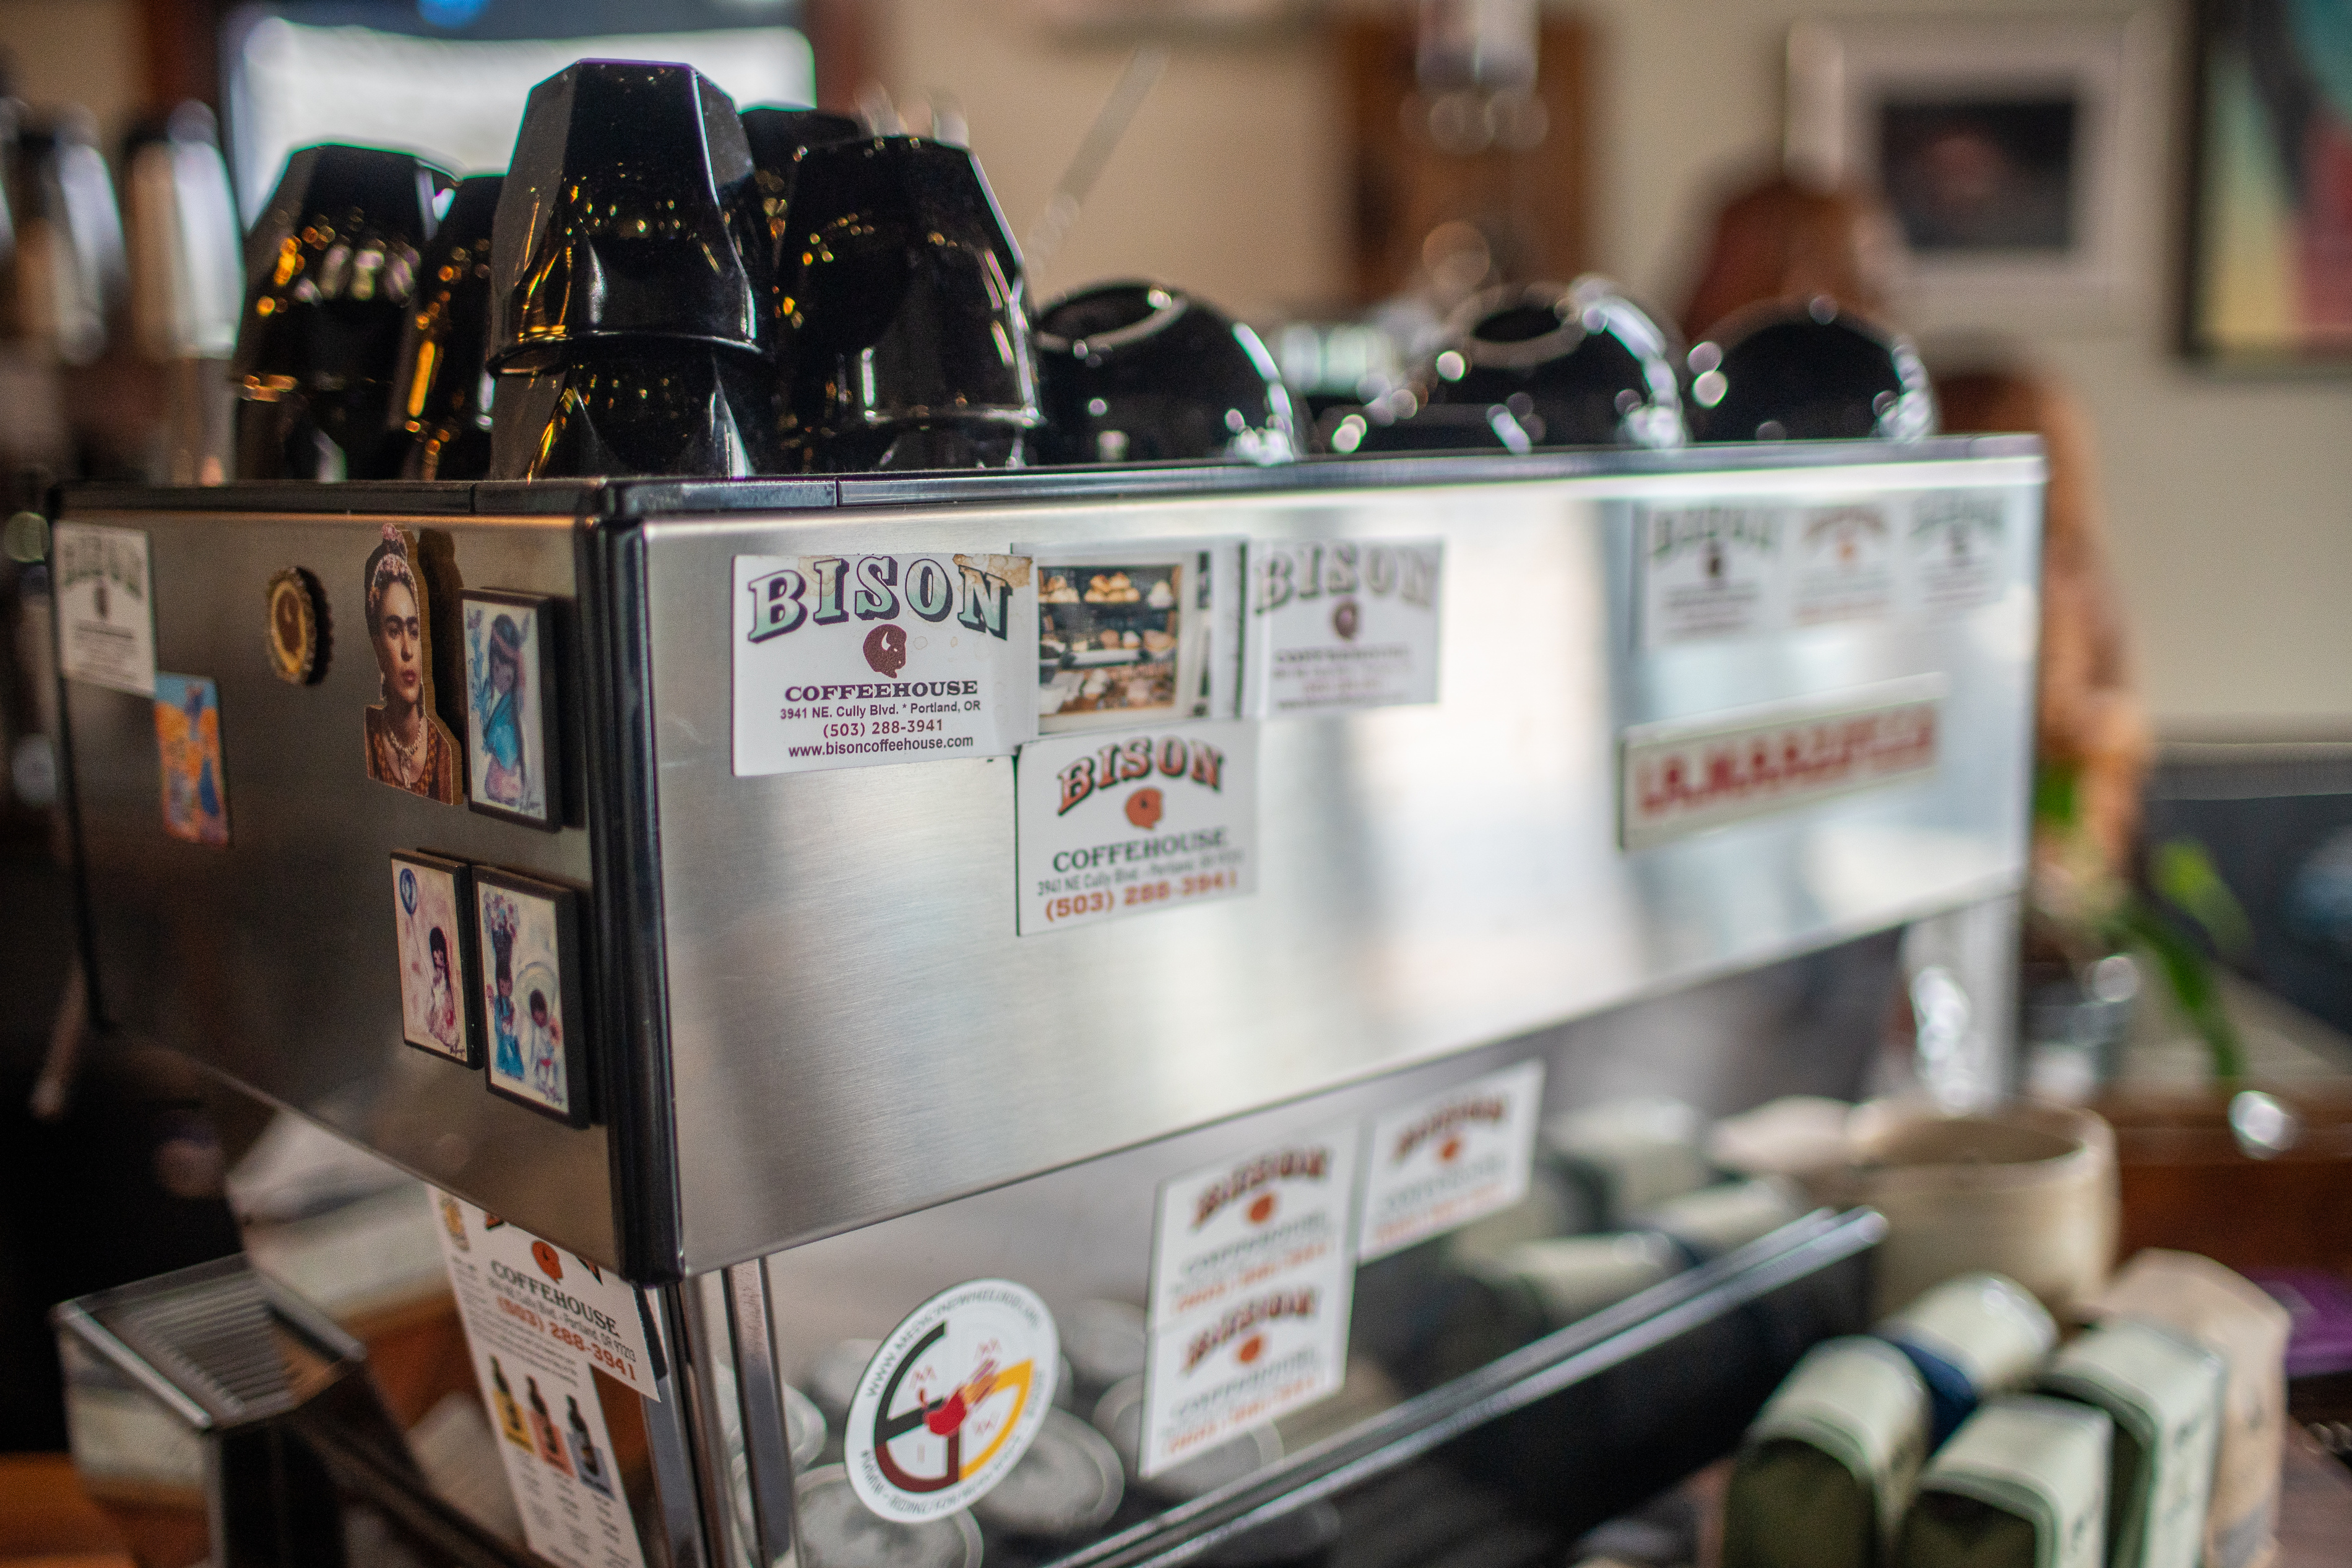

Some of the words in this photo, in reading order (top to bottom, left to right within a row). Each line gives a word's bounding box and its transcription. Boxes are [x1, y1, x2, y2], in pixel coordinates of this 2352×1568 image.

[747, 555, 1014, 644] BISON
[780, 708, 807, 720] 3941
[812, 707, 832, 718] NE.
[836, 705, 866, 718] Cully
[870, 704, 899, 717] Blvd.
[910, 701, 961, 714] Portland,
[964, 700, 980, 711] OR
[785, 680, 978, 702] COFFEEHOUSE
[788, 736, 974, 757] www.bisoncoffeehouse.com
[823, 722, 865, 739] (503)
[871, 719, 943, 735] 288-3941
[1057, 736, 1225, 817] BISON
[1052, 825, 1227, 873] COFFEHOUSE
[1045, 890, 1113, 923] (503)
[491, 1260, 620, 1338] COFFEHOUSE
[549, 1320, 636, 1382] 288-3941
